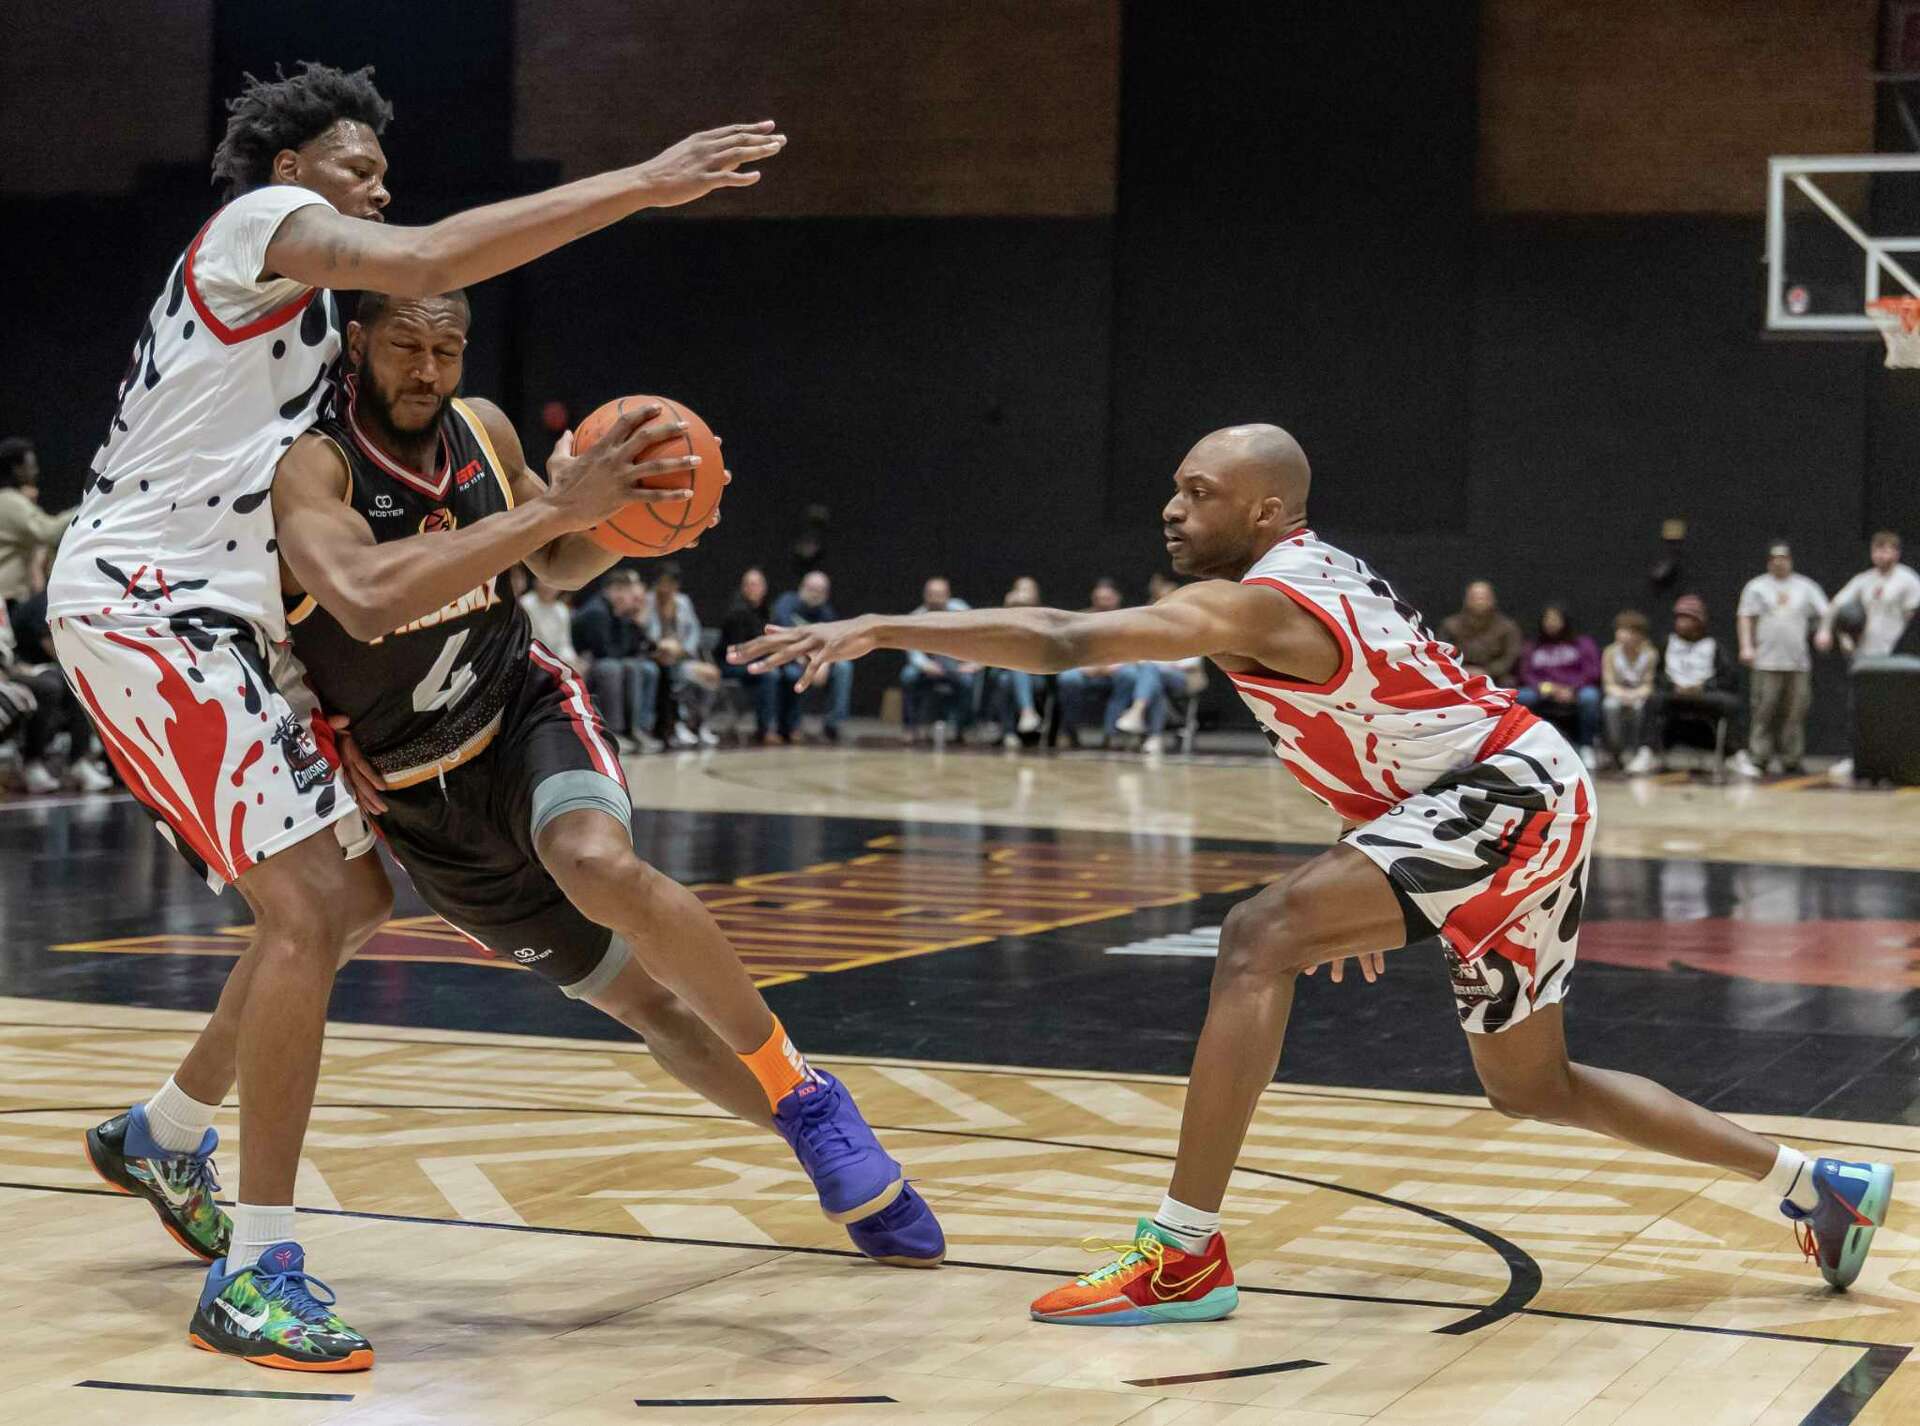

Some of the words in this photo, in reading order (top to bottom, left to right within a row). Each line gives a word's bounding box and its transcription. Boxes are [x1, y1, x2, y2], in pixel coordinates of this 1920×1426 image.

[368, 508, 404, 518] WOOTER
[412, 627, 477, 712] 4
[294, 757, 329, 789] CRUSAD
